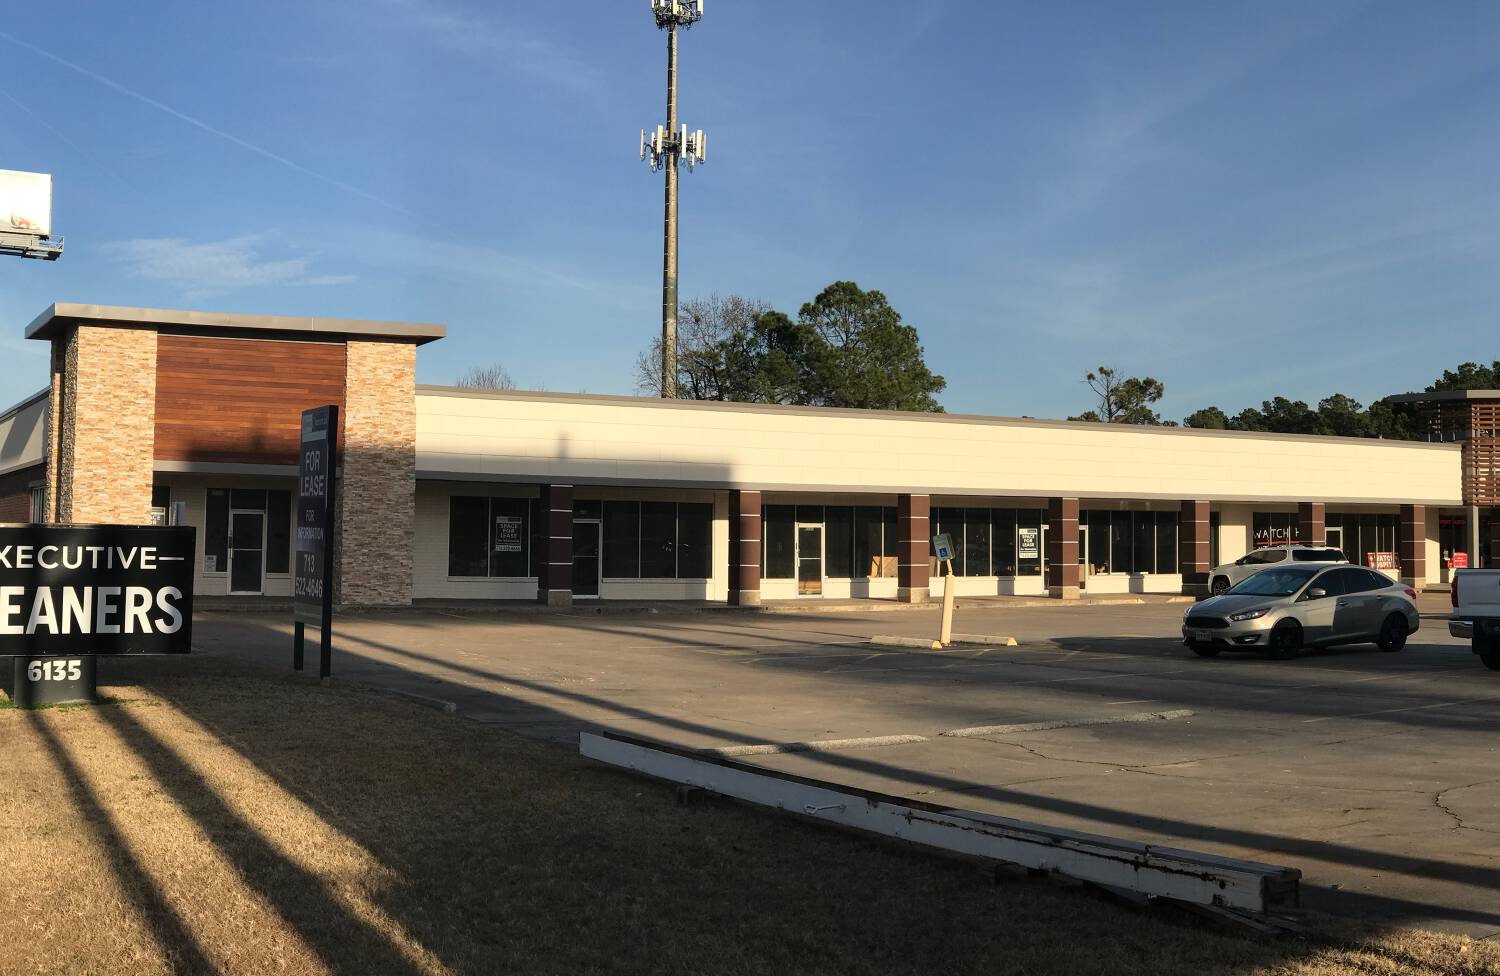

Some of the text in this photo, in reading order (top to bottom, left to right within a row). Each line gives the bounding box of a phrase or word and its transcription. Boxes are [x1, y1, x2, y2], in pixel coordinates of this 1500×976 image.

[305, 450, 320, 471] FOR
[300, 475, 324, 496] LEASE
[1254, 527, 1289, 539] WATCH
[303, 553, 315, 573] 713
[27, 658, 82, 682] 6135
